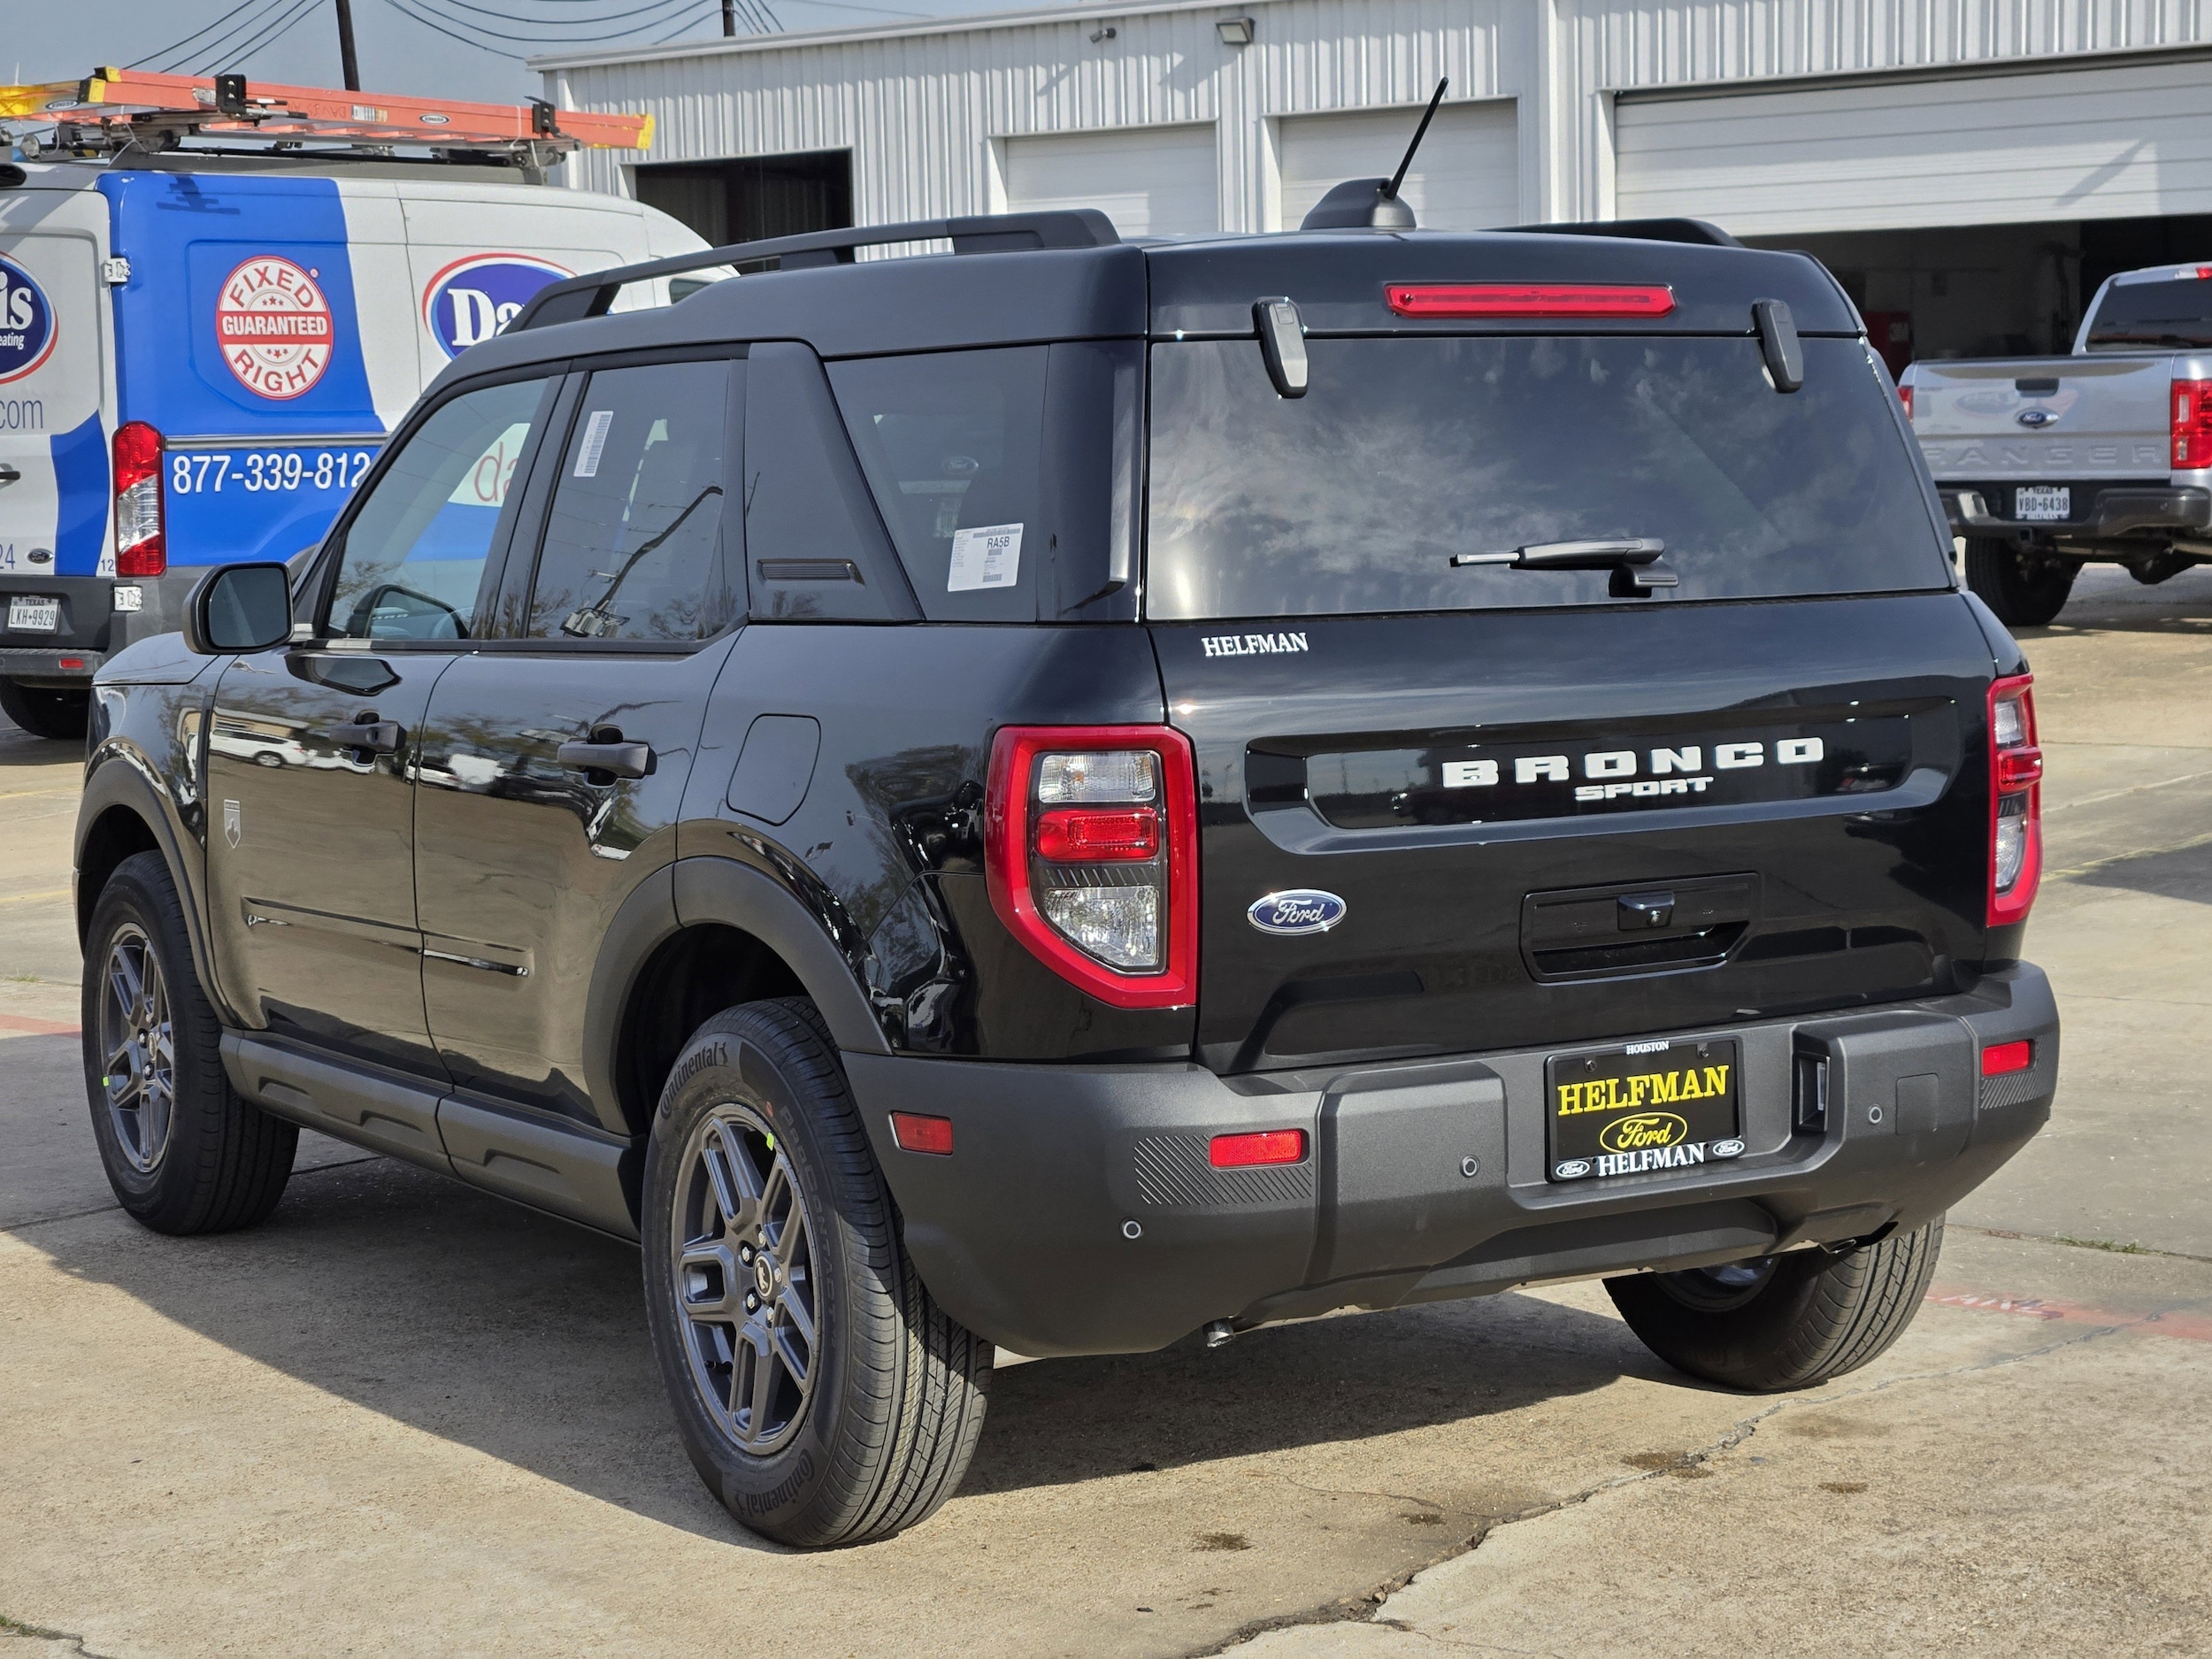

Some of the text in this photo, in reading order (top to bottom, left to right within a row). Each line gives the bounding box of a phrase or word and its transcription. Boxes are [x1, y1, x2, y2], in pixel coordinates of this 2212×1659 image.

[229, 265, 314, 308] FIXED
[222, 316, 327, 335] GUARANTEED
[234, 349, 319, 392] RIGHT
[987, 536, 1010, 549] RA5B
[1201, 632, 1310, 657] HELFMAN
[1441, 736, 1824, 788] BRONCO
[1574, 776, 1715, 801] SPORT
[1625, 1041, 1670, 1056] HOUSTON
[660, 1041, 718, 1120] Continental
[1557, 1064, 1730, 1116] HELFMAN
[1617, 1117, 1673, 1148] Ford
[1598, 1142, 1707, 1177] HELFMAN
